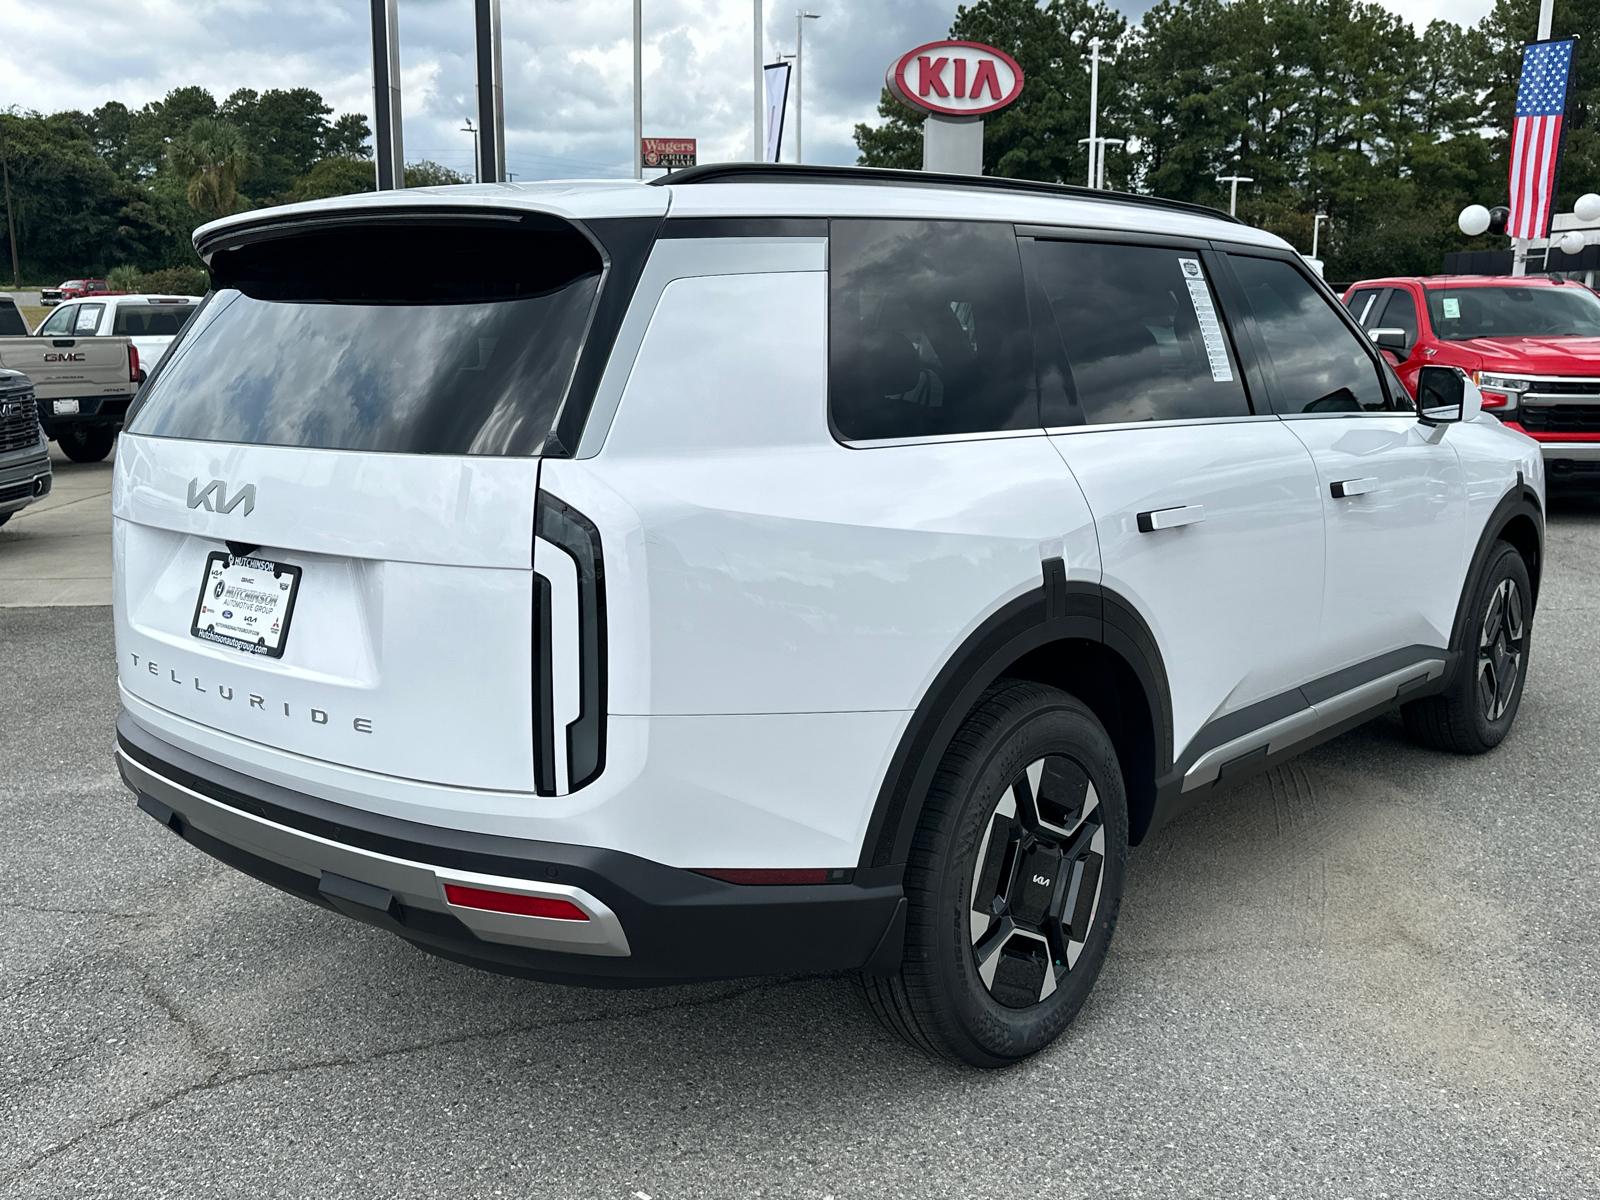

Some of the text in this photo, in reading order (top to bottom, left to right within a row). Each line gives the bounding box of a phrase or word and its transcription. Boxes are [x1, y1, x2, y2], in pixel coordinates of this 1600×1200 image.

[917, 56, 1002, 100] KIA
[645, 140, 694, 153] Wagers
[43, 353, 86, 362] GMC
[187, 477, 257, 517] KIA
[234, 556, 275, 572] HUTCHINSON
[225, 586, 279, 607] HUTCHINSON
[223, 599, 254, 612] AUTOMOTIVE
[254, 605, 274, 615] GROUP
[131, 653, 373, 734] TELLURIDE
[1032, 874, 1051, 888] KIA
